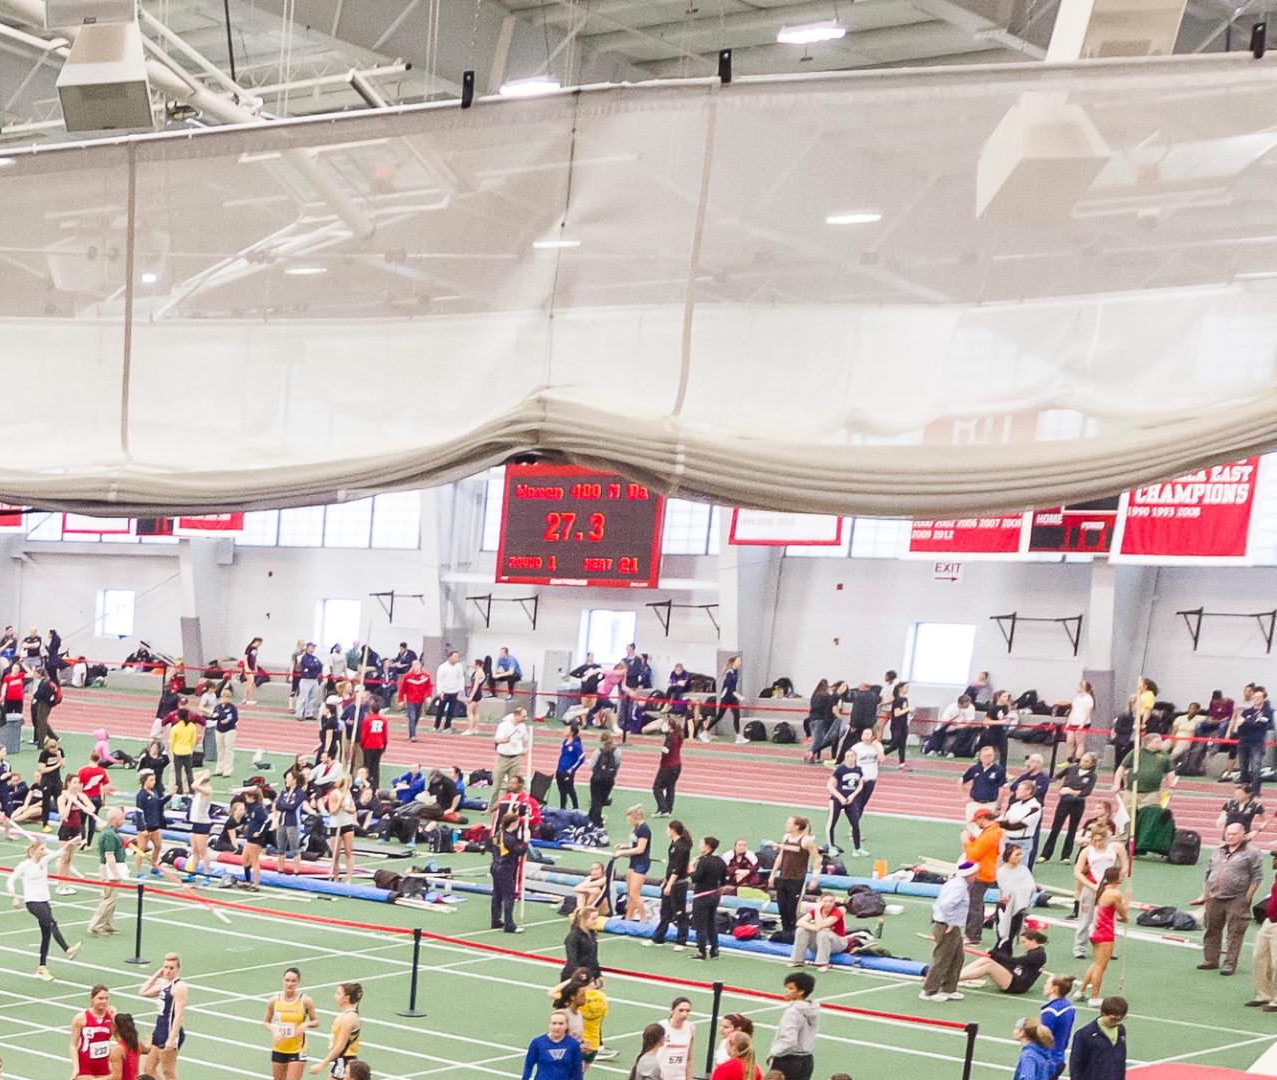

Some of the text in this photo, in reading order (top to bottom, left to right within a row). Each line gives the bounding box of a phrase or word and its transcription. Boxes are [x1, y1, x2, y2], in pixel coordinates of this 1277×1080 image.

[1208, 465, 1254, 482] EAST
[571, 484, 602, 500] 400
[1135, 483, 1250, 505] CHAMPIONS
[544, 512, 605, 543] 27.3
[1036, 513, 1064, 526] HOME
[619, 557, 639, 574] 21
[934, 562, 963, 574] EXIT
[370, 719, 385, 733] R
